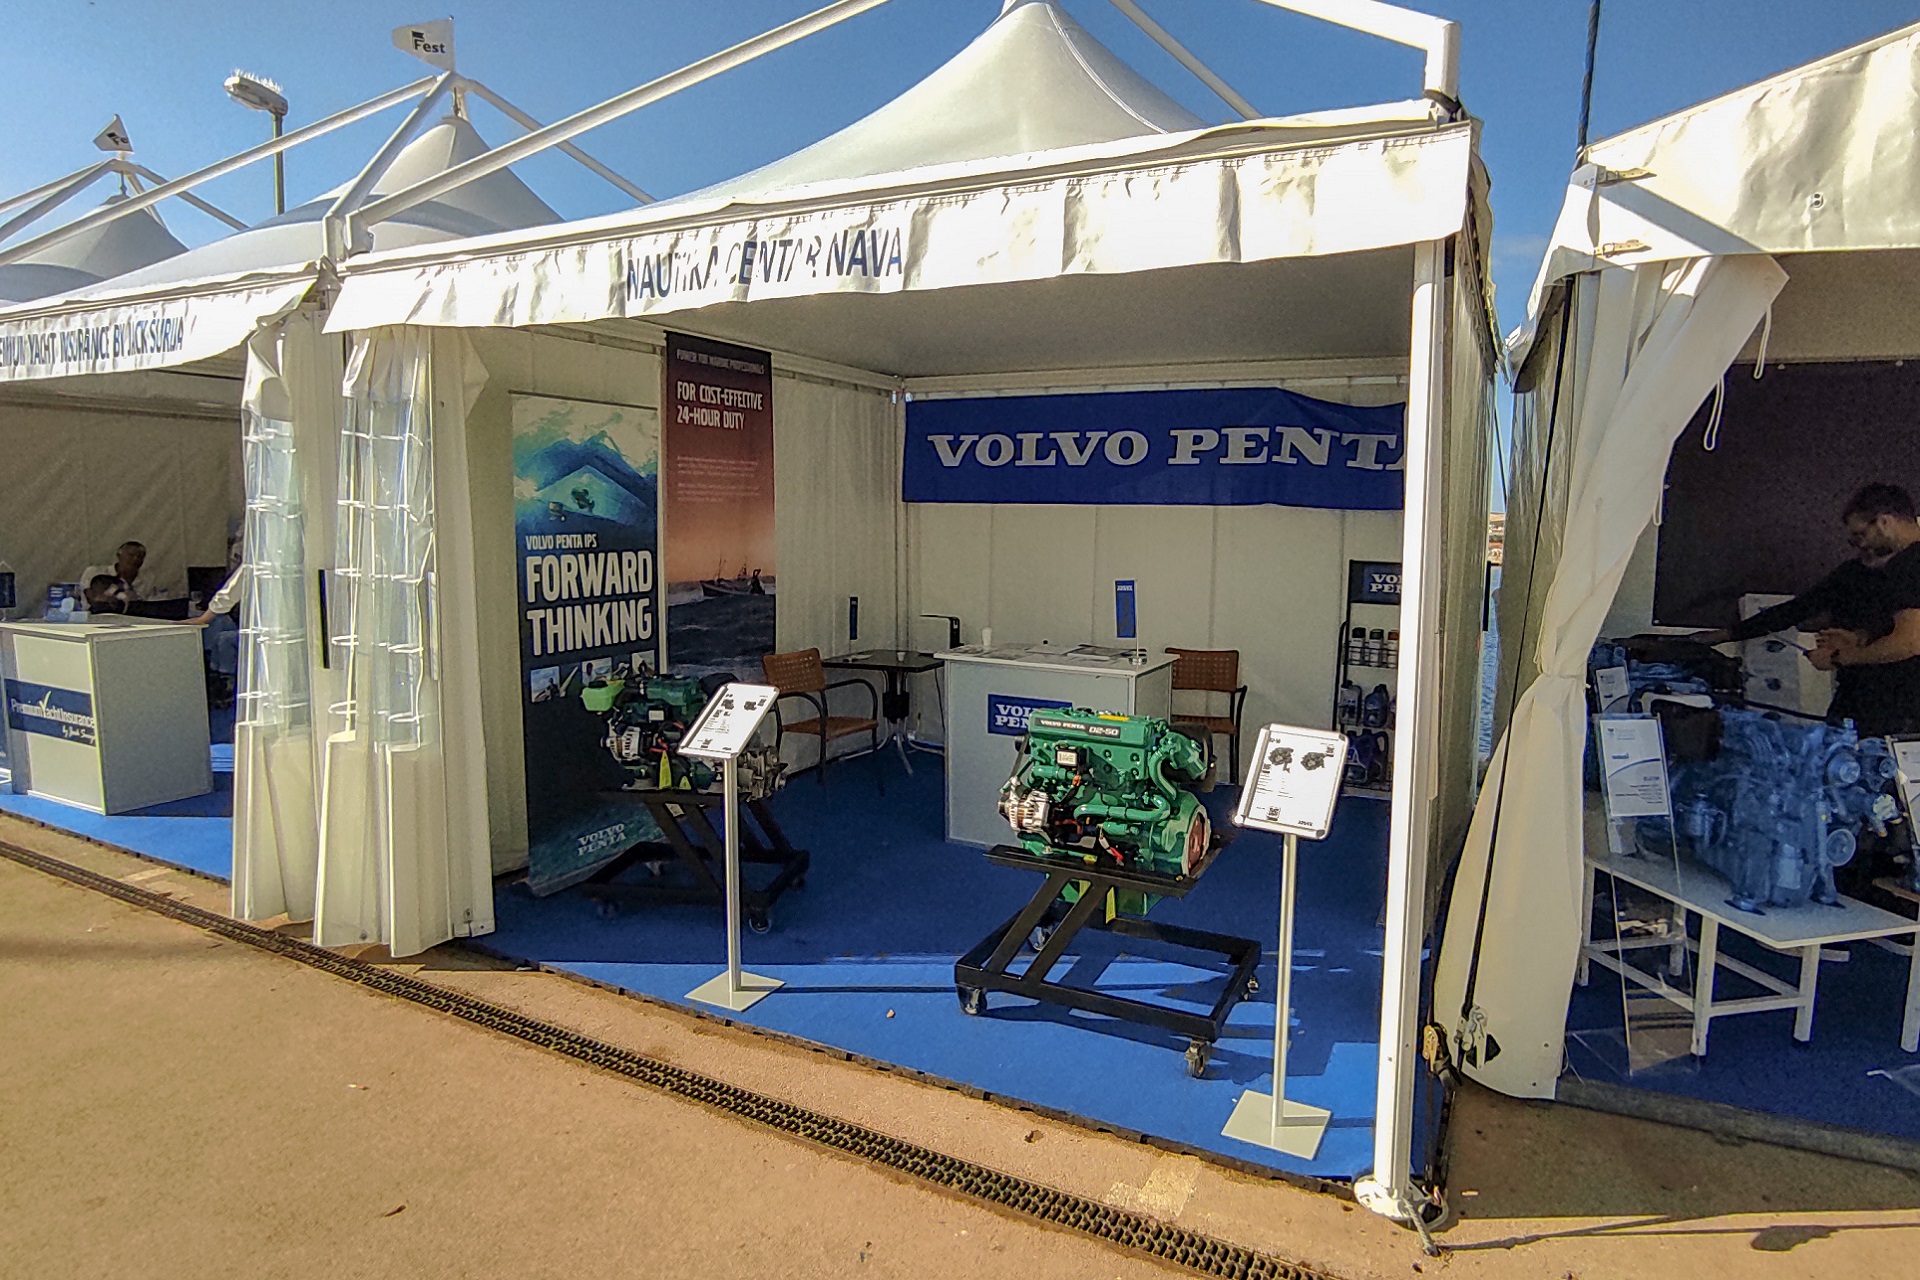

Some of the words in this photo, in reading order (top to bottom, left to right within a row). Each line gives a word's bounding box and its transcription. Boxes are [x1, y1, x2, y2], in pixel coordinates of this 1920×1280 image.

[412, 36, 446, 54] Fest
[826, 227, 903, 277] NAVA
[28, 332, 56, 365] YACHT
[113, 322, 126, 358] BY
[677, 381, 696, 401] FOR
[699, 385, 763, 411] COST-EFFECTIVE
[677, 405, 720, 427] 24-HOUR
[723, 411, 745, 430] DUTY
[927, 431, 1149, 467] VOLVO
[525, 535, 554, 550] VOLVO
[555, 534, 583, 549] PENTA
[584, 534, 597, 548] IPS
[526, 550, 653, 603] FORWARD
[526, 598, 652, 656] THINKING
[1040, 719, 1061, 727] VOLVO
[1062, 722, 1085, 730] PENTA
[1088, 726, 1119, 736] D2-50
[577, 823, 625, 846] VOLVO
[577, 832, 626, 856] PENTA
